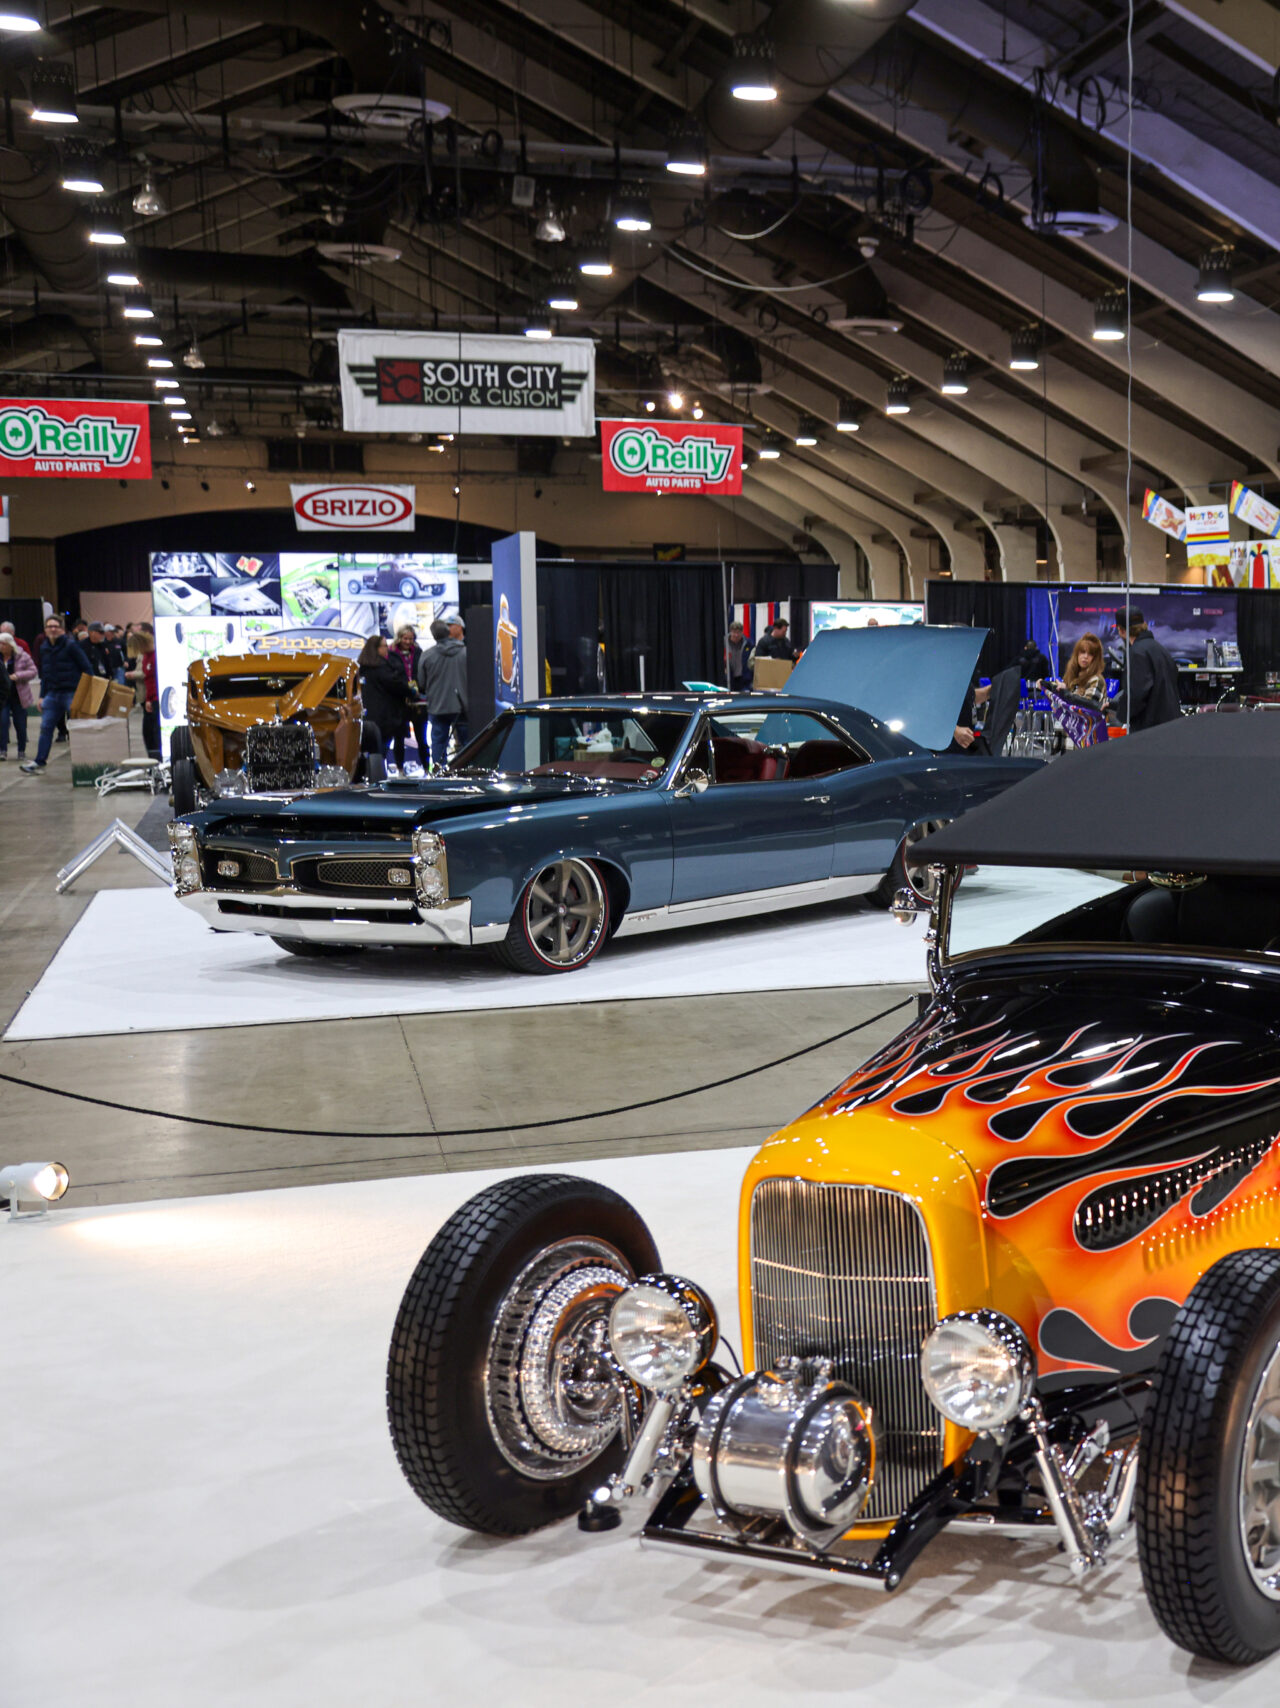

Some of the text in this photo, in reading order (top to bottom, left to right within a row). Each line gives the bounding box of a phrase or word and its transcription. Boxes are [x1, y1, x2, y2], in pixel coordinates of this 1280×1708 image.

[423, 361, 557, 390] SOUTH CITY
[424, 387, 559, 407] ROD & CUSTOM
[0, 415, 128, 458] O'Reilly
[618, 436, 724, 475] O'Reilly
[34, 461, 101, 472] AUTO PARTS
[646, 477, 701, 488] AUTO PARTS
[312, 499, 396, 516] BRIZIO
[1189, 511, 1224, 521] HOT DOG
